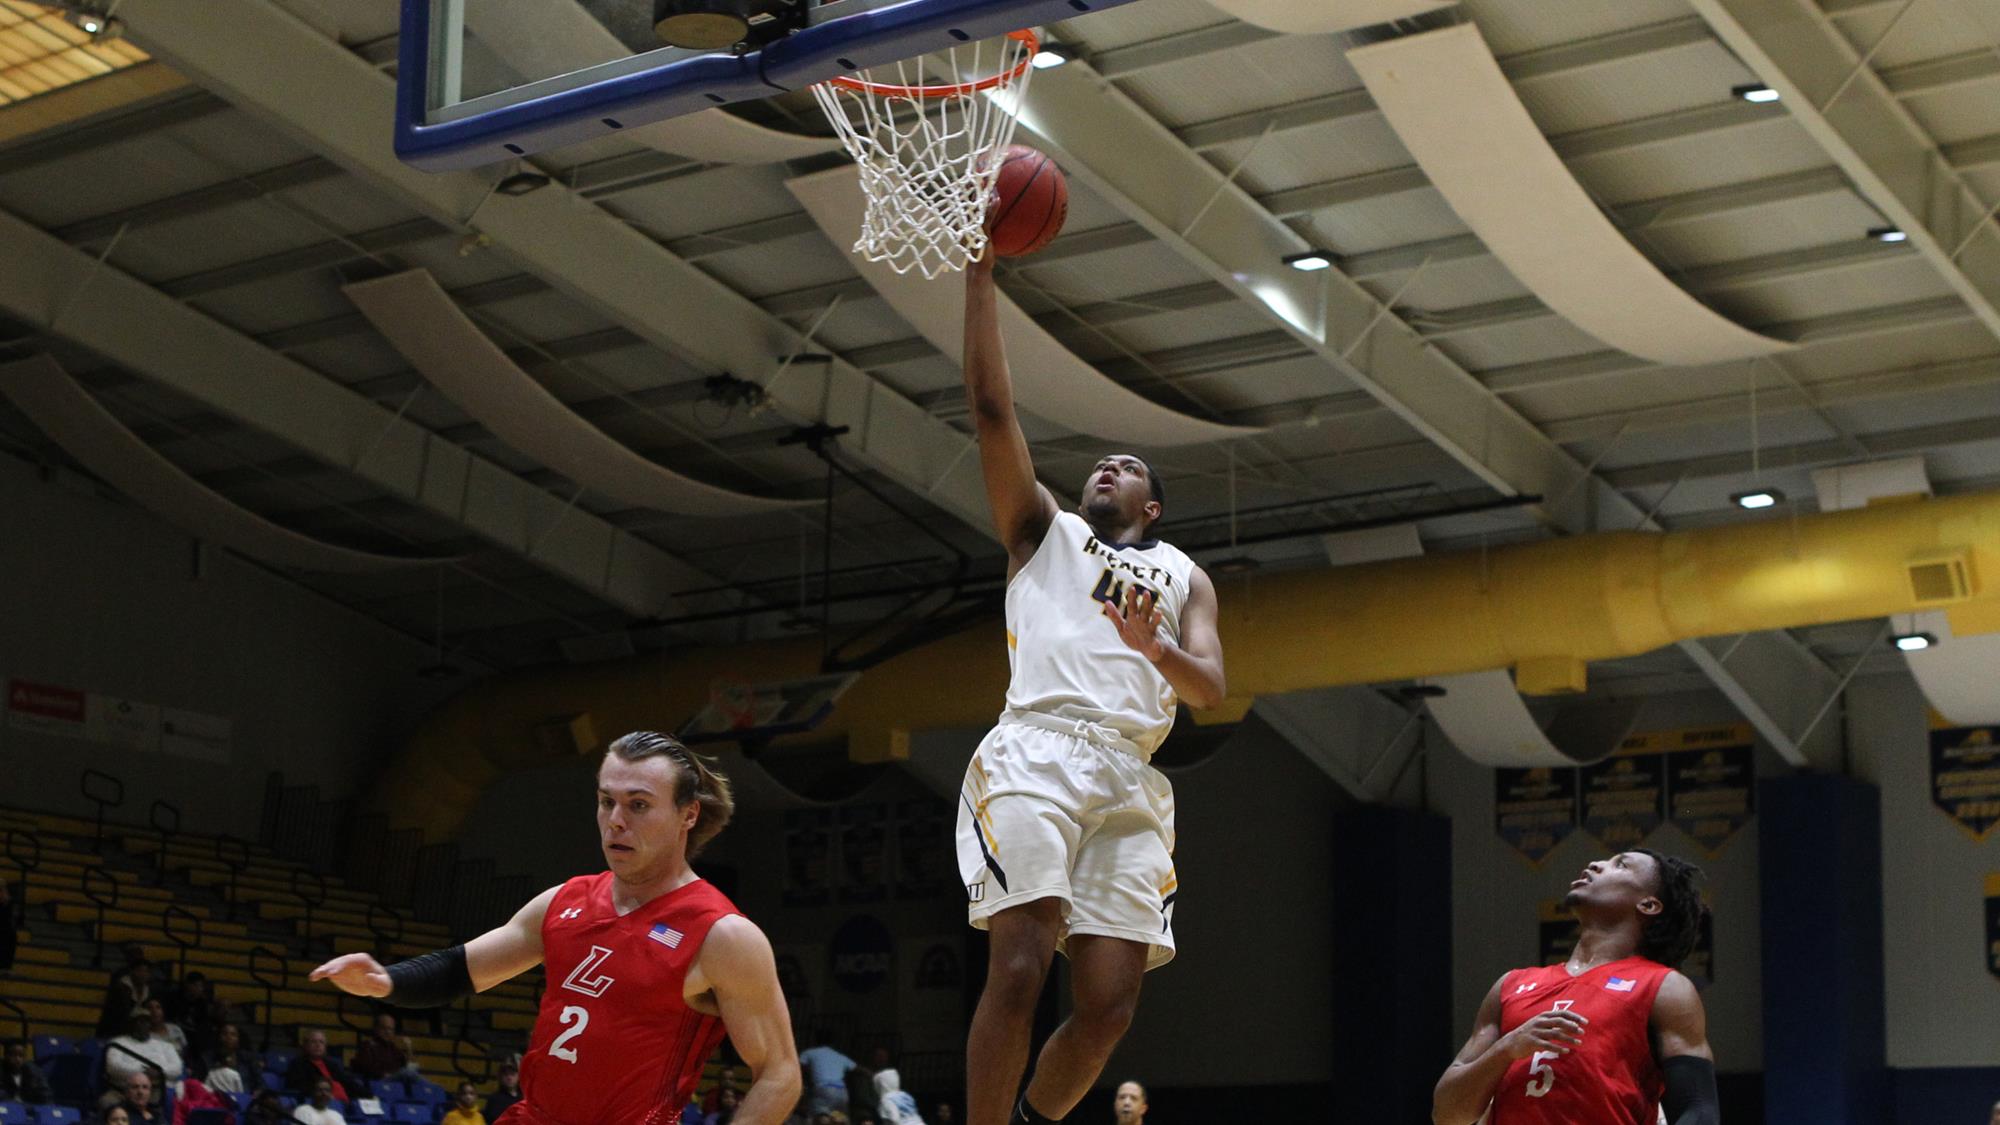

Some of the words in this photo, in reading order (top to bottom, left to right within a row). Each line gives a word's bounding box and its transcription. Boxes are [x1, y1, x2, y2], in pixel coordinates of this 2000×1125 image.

[560, 944, 615, 998] L
[548, 1005, 590, 1065] 2
[1525, 1049, 1560, 1098] 5
